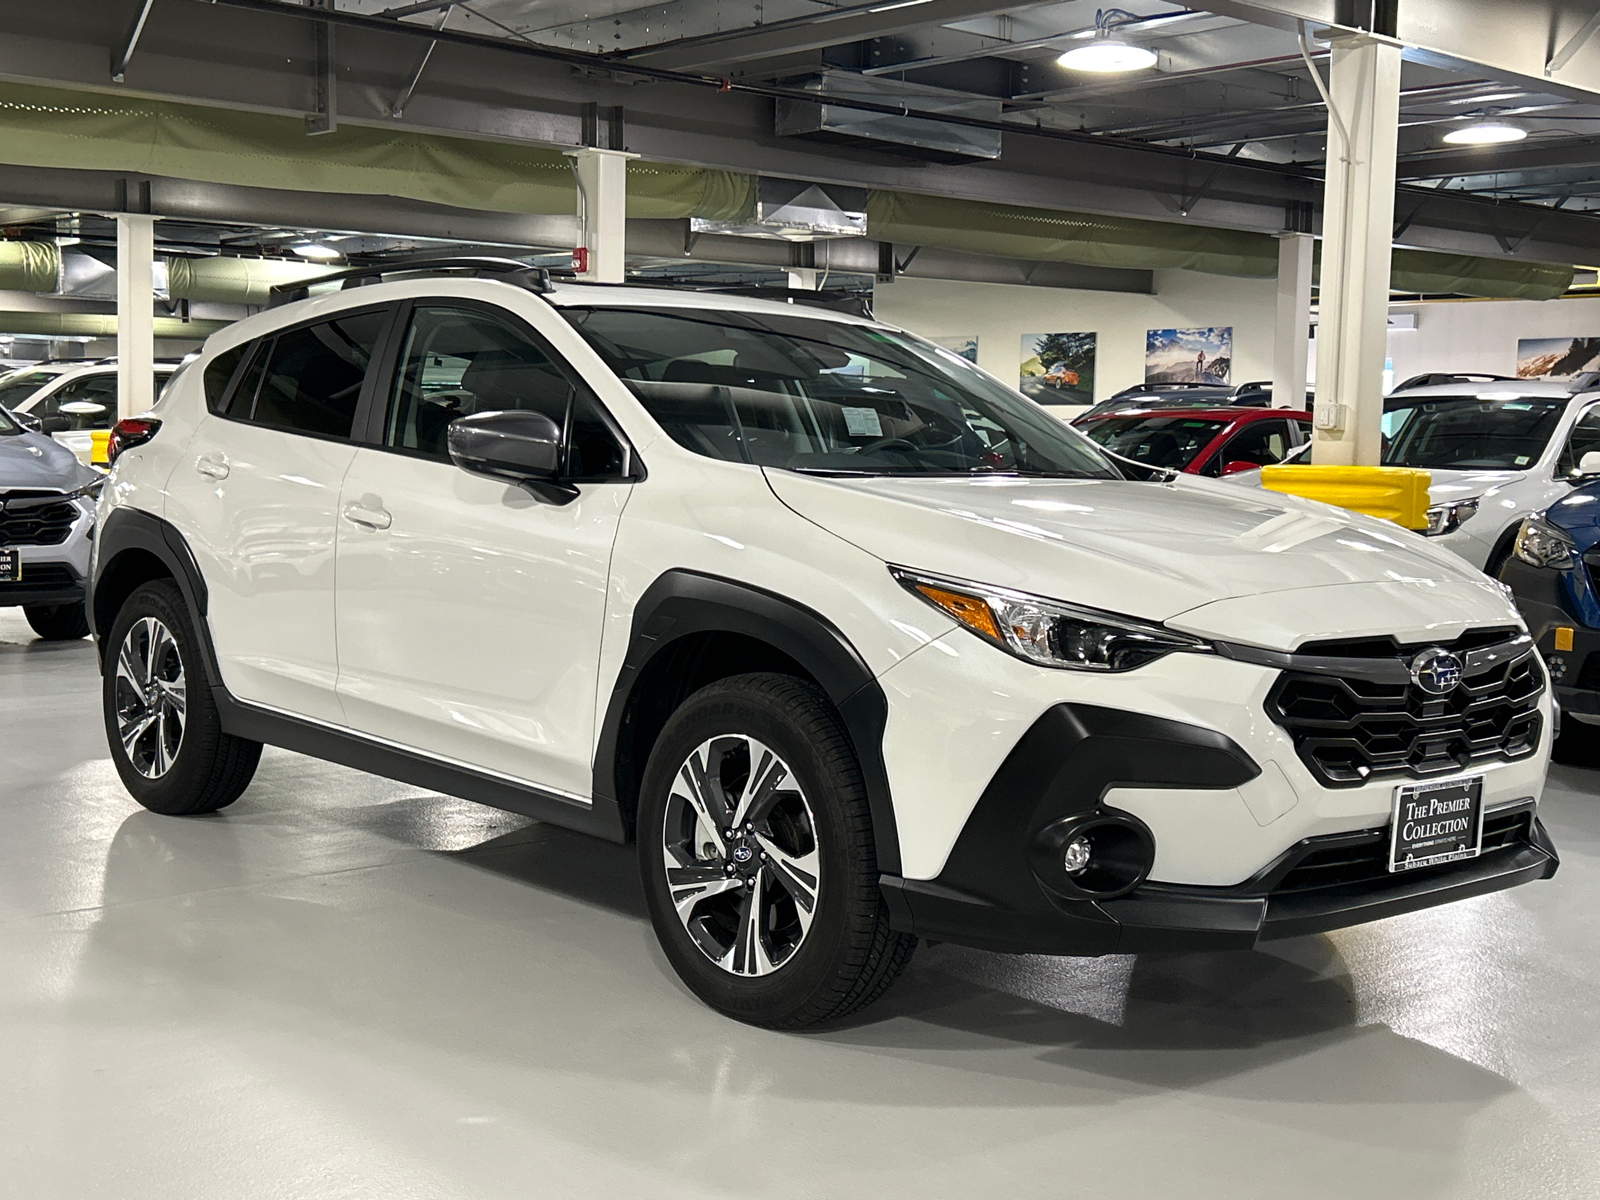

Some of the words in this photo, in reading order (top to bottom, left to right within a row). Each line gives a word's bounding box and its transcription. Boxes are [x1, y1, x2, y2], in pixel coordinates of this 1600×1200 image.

[1406, 802, 1428, 821] THE
[1429, 798, 1470, 816] PREMIER
[1403, 817, 1469, 841] COLLECTION
